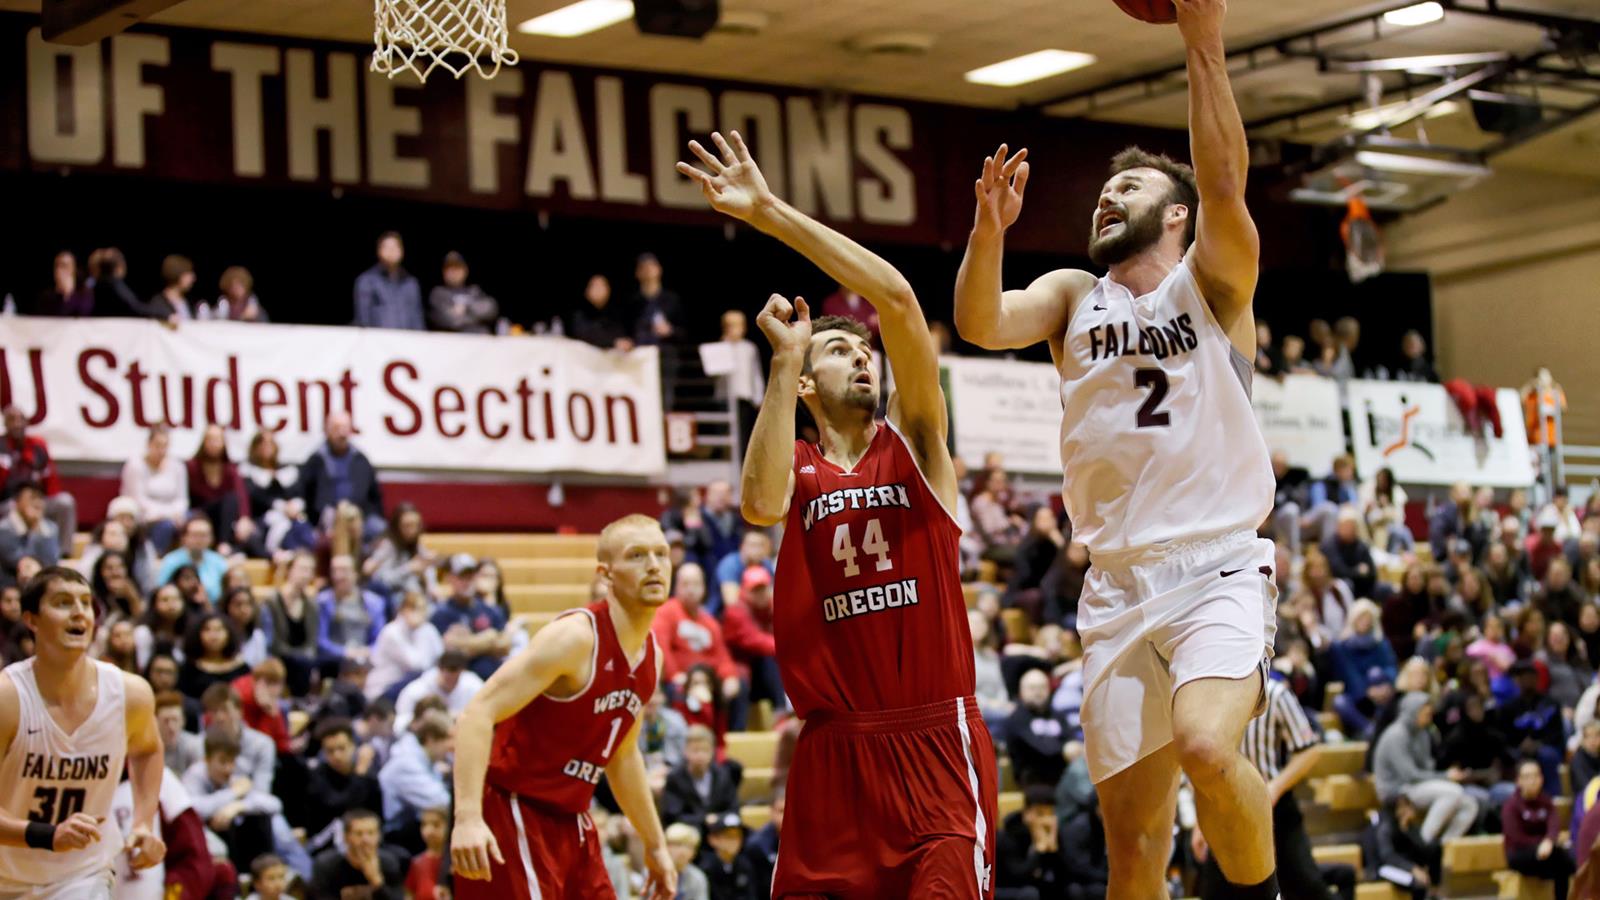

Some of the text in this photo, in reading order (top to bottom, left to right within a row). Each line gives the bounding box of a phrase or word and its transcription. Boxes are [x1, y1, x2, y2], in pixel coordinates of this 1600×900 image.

[26, 26, 917, 226] OF THE FALCONS
[1088, 312, 1199, 361] FALCONS
[77, 346, 361, 434] Student
[383, 360, 640, 444] Section
[1133, 366, 1172, 429] 2
[801, 483, 912, 532] WESTERN
[832, 517, 893, 578] 44
[823, 578, 920, 622] OREGON
[601, 716, 623, 759] 1
[22, 752, 110, 781] FALCONS
[28, 786, 87, 827] 30
